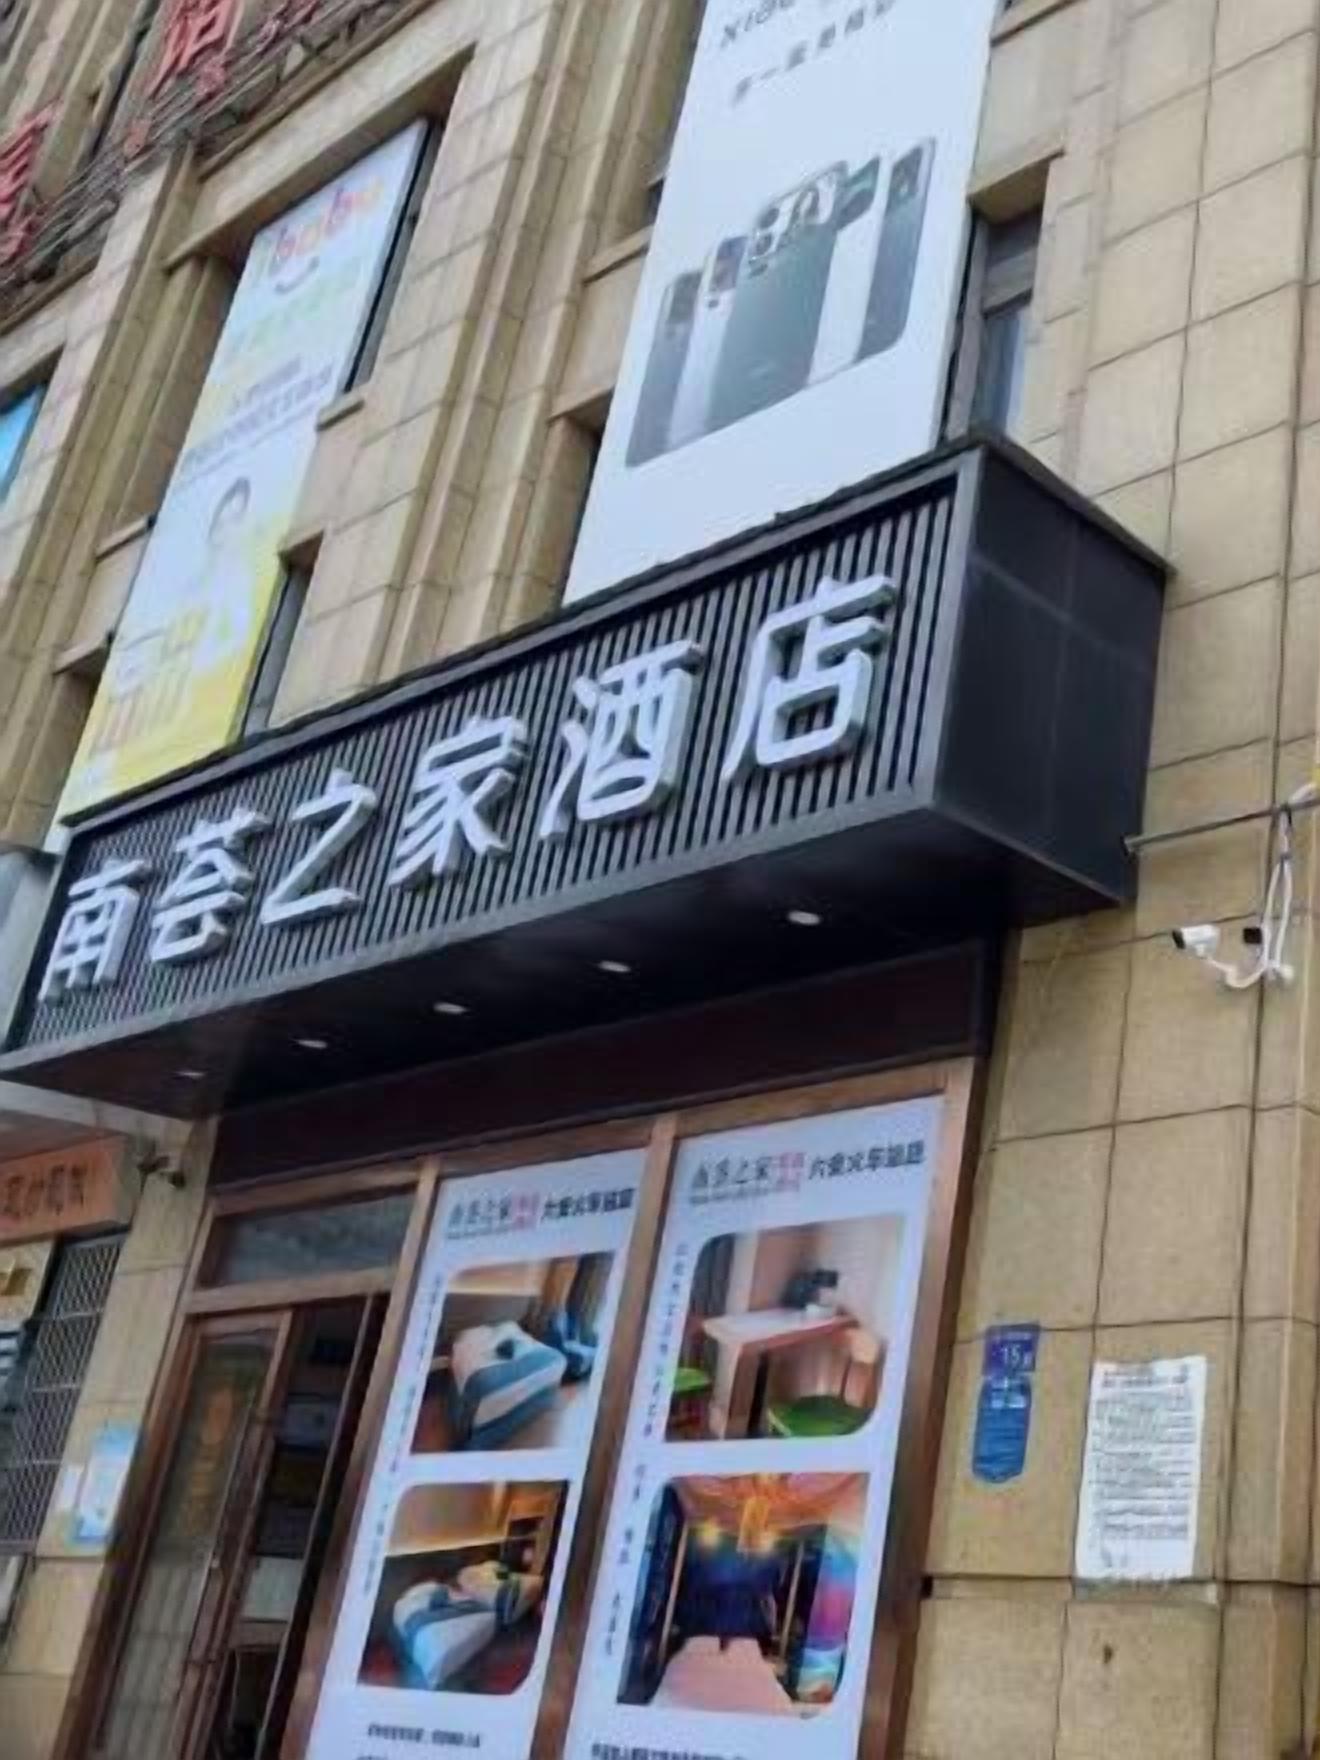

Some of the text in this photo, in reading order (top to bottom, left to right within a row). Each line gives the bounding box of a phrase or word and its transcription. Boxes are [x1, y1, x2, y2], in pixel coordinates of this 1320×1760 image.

[38, 575, 897, 1001] 南荟之家酒店
